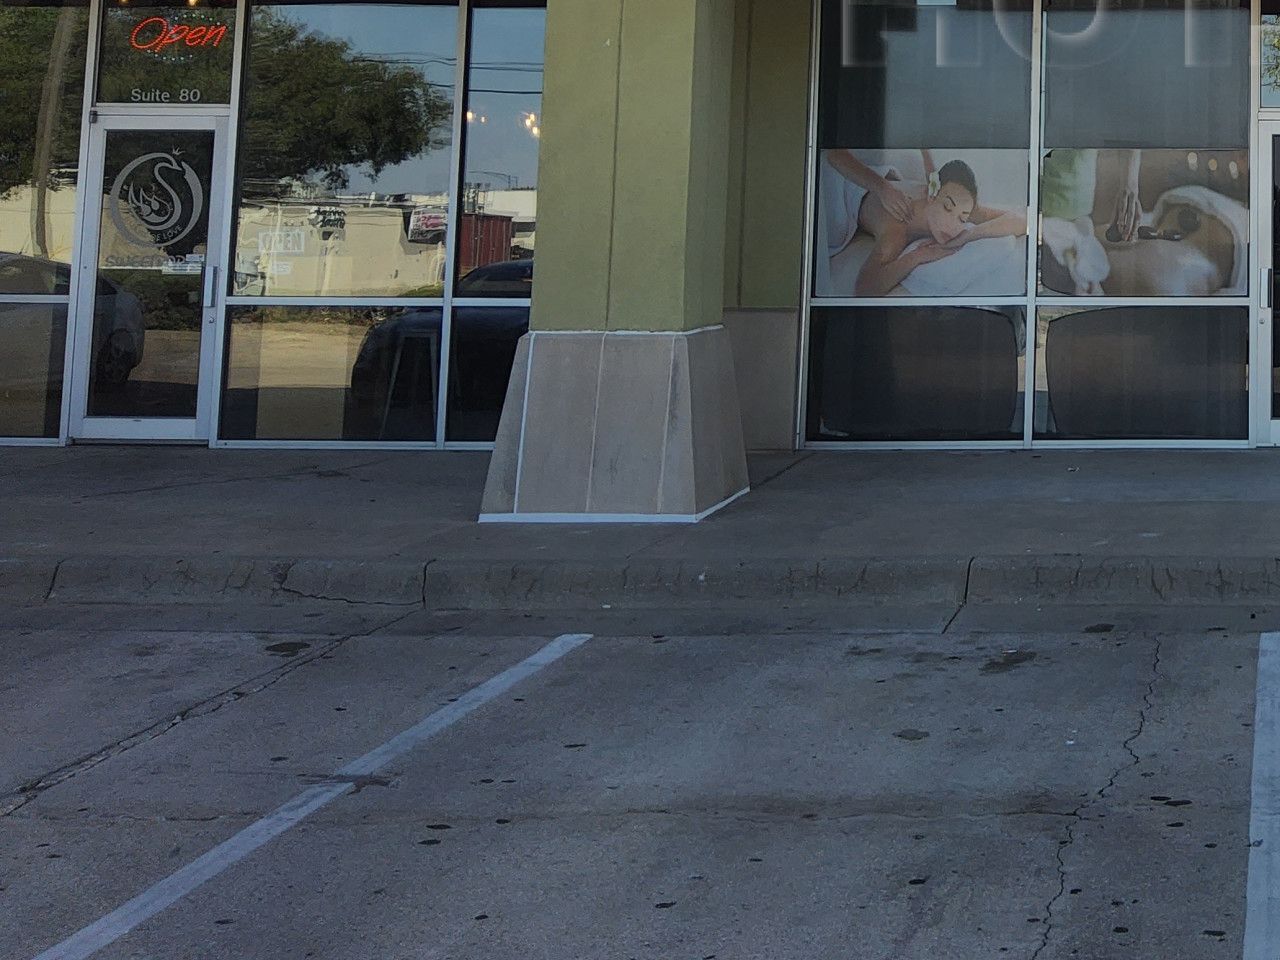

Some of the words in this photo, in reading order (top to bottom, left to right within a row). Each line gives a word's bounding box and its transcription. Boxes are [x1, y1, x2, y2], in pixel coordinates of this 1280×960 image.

[130, 17, 228, 53] Open
[130, 87, 171, 103] Suite
[178, 88, 201, 103] 80
